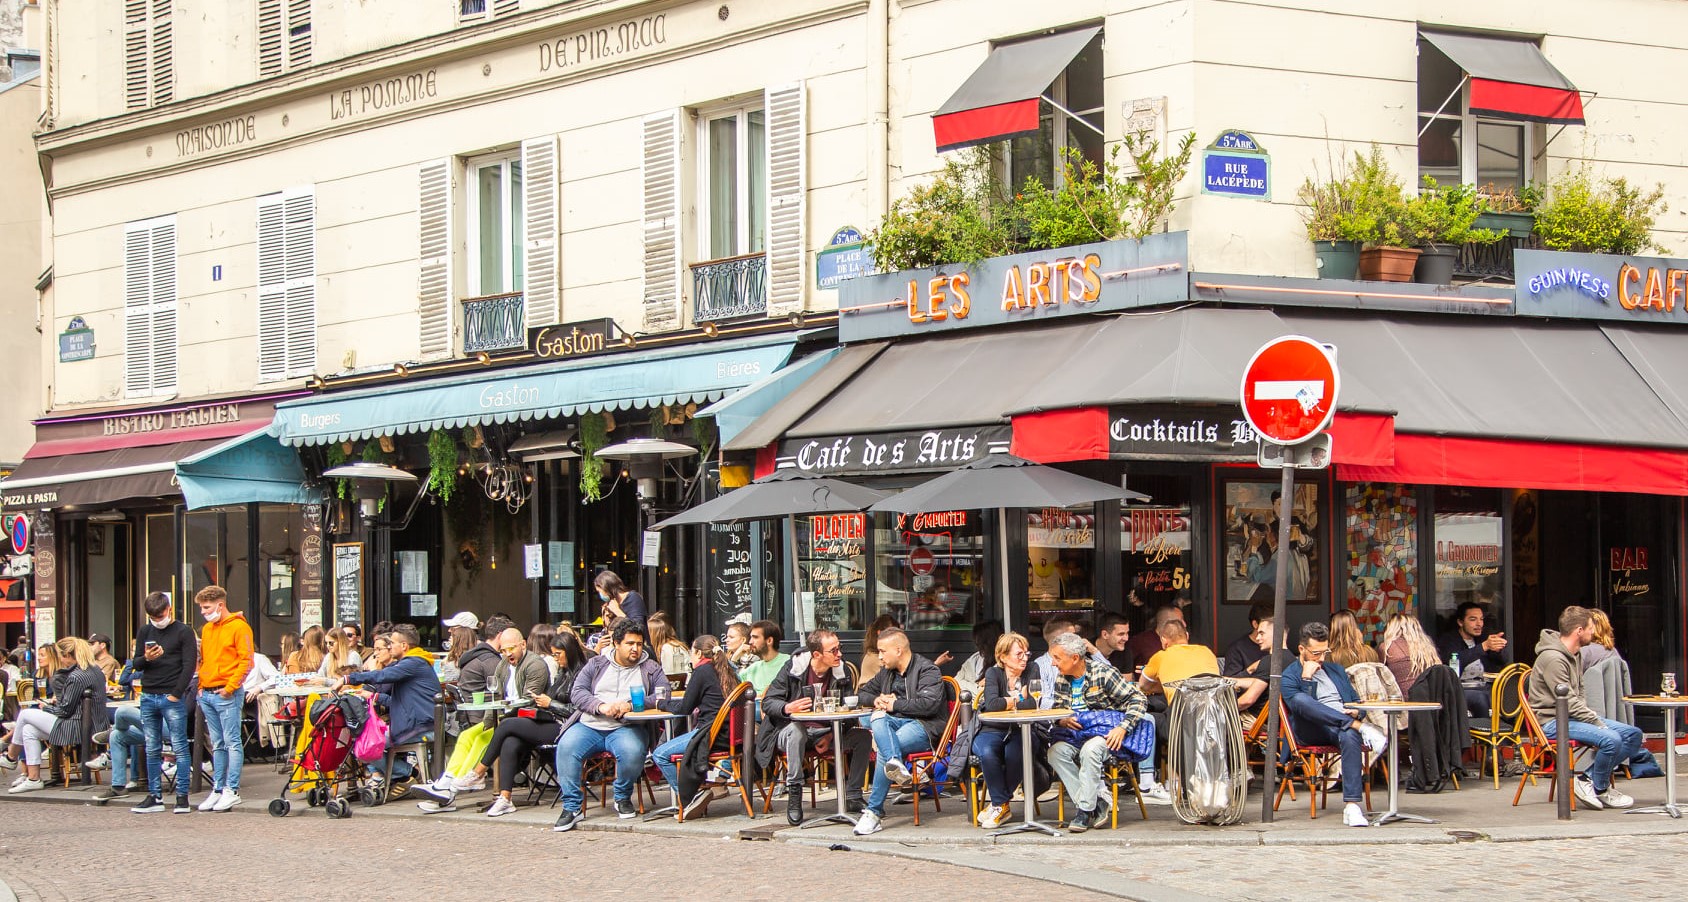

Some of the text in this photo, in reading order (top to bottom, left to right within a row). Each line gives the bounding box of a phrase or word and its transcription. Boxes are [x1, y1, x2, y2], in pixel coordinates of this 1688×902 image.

[1207, 174, 1265, 189] LACÉPÈDE
[1225, 163, 1248, 176] RUE
[836, 252, 861, 263] PLACE
[837, 263, 860, 274] DE LA
[907, 252, 1101, 324] LES ARTS
[1617, 262, 1688, 313] CAF
[535, 325, 605, 358] Gaston
[479, 382, 541, 409] Gaston
[103, 402, 241, 436] BISTRO ITALIEN
[301, 413, 341, 430] Burgers
[1109, 417, 1219, 444] Cocktails
[797, 431, 978, 470] Café des Arts
[3, 491, 58, 506] PIZZA & PASTA
[1130, 509, 1183, 556] PINTE
[1447, 540, 1499, 563] GRIGNOTER
[1610, 547, 1649, 571] BAR
[1172, 566, 1192, 590] 5€
